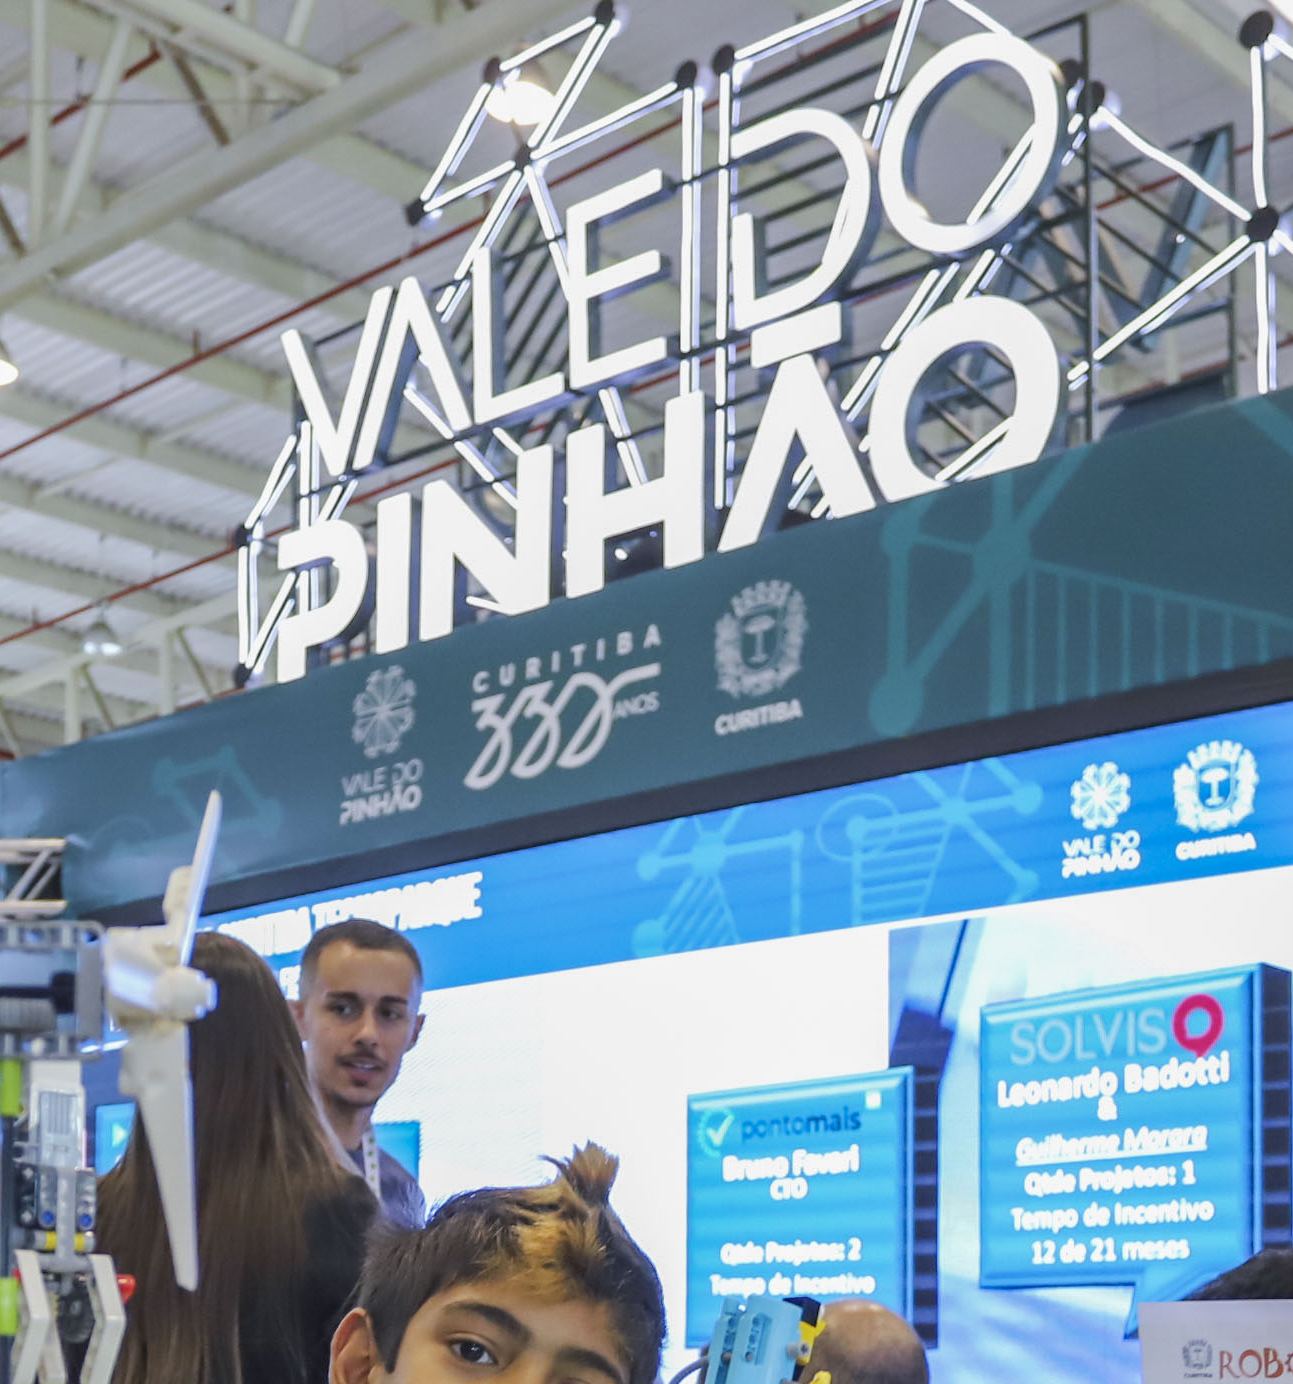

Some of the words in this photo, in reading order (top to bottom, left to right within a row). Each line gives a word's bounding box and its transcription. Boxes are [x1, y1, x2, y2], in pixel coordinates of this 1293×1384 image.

[281, 168, 668, 476] VALE
[731, 31, 1059, 330] DO
[277, 295, 1060, 684] PINHÃO
[472, 623, 661, 693] CURITIBA
[613, 691, 660, 718] ANOS
[714, 698, 803, 736] CURITIBA
[342, 766, 386, 797] VALE
[392, 758, 423, 785] DO
[1062, 834, 1106, 857] VALE
[1010, 1007, 1167, 1066] SOLVIS
[997, 1066, 1118, 1108] Leonardo
[1182, 1160, 1196, 1185] 1
[1011, 1207, 1079, 1234] Tempo
[1083, 1201, 1111, 1227] de
[1114, 1198, 1215, 1225] Incentivo
[847, 1237, 862, 1261] 2
[1032, 1240, 1056, 1265] 12
[1060, 1238, 1086, 1263] de
[1090, 1237, 1117, 1262] 21
